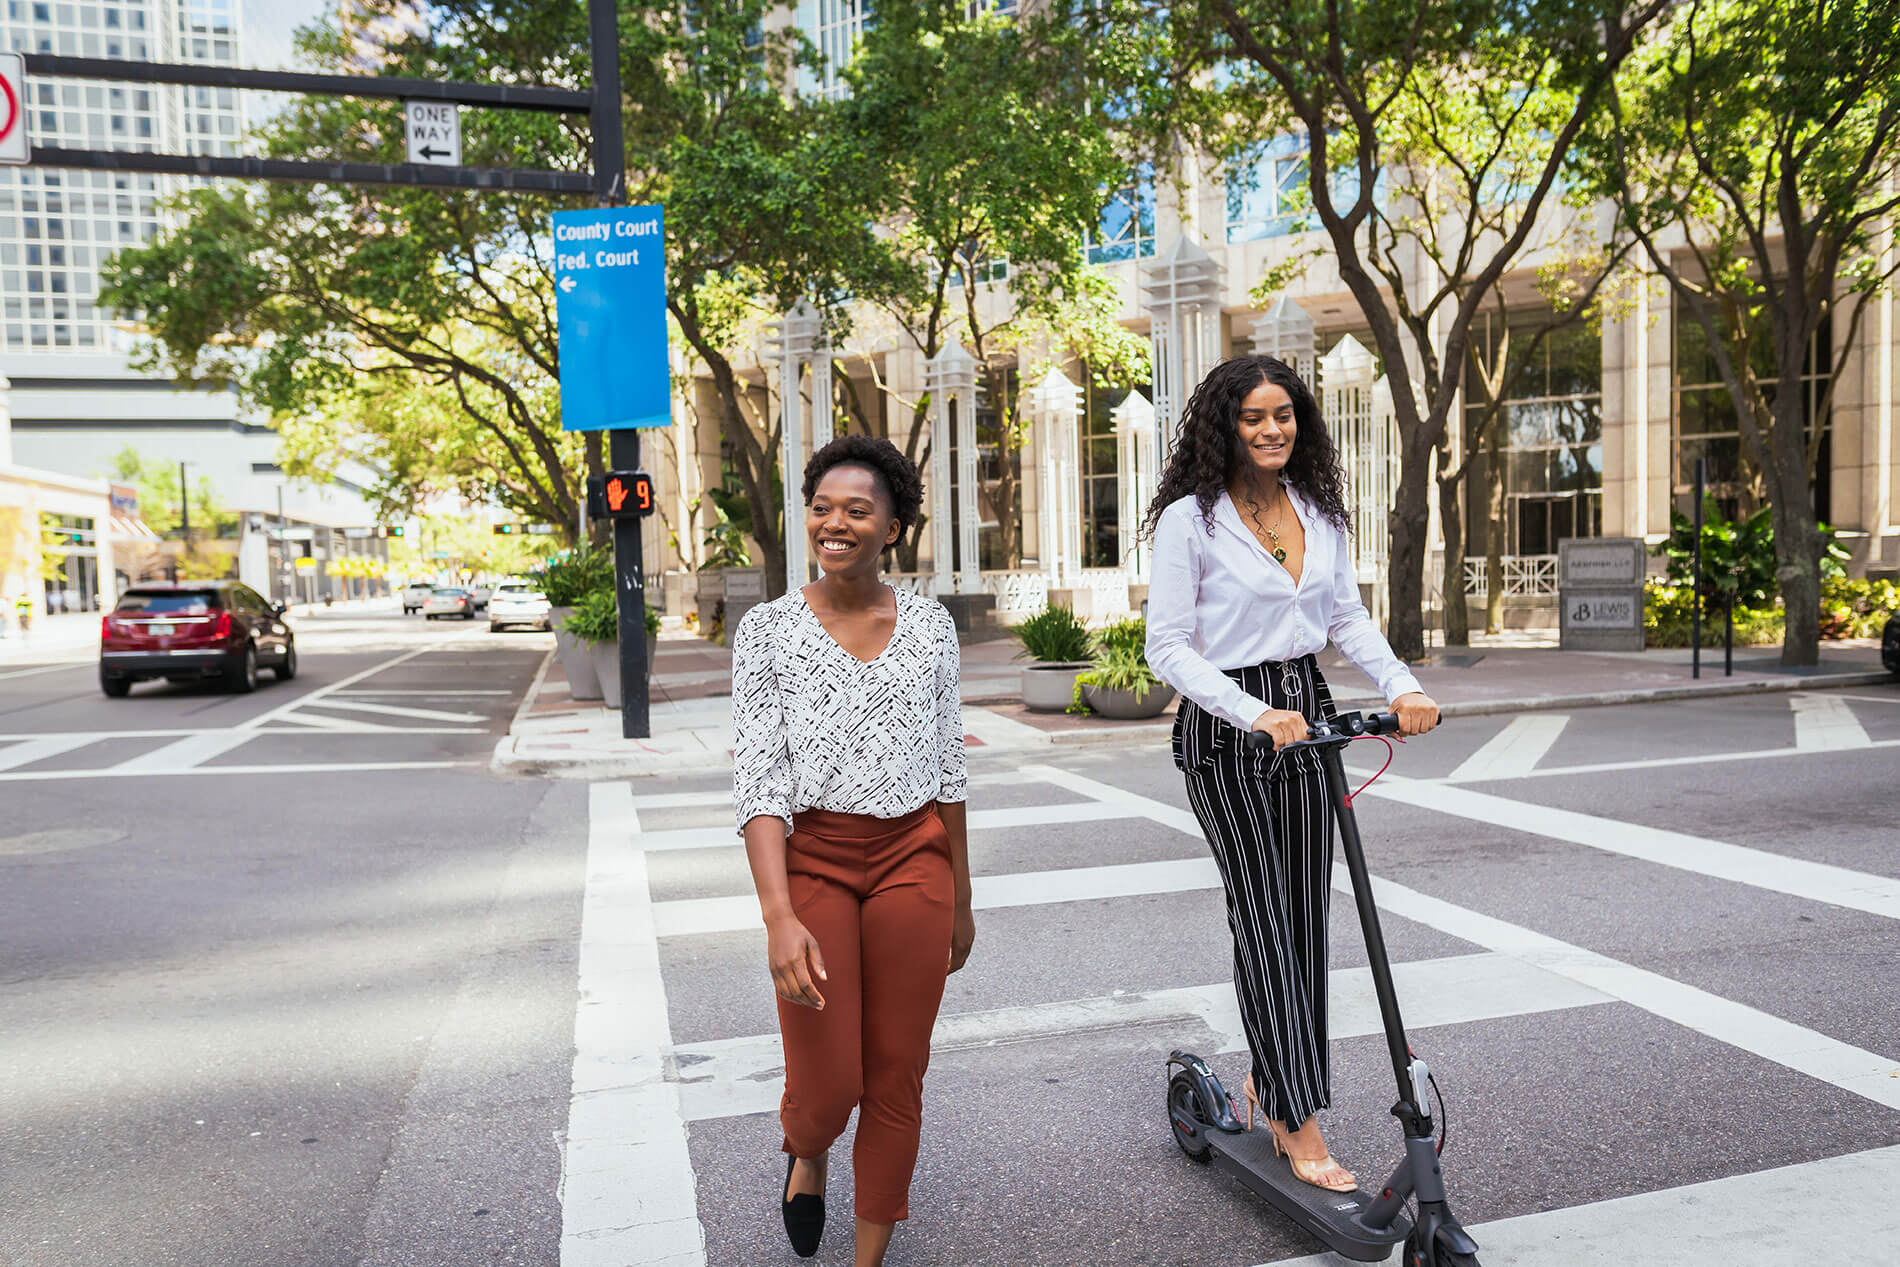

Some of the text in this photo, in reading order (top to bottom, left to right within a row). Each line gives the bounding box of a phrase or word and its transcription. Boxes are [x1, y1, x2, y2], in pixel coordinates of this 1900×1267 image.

[414, 106, 450, 123] ONE
[412, 125, 452, 141] WAY
[556, 218, 659, 241] County Court
[557, 249, 639, 270] Fed. Court
[636, 480, 650, 509] 9
